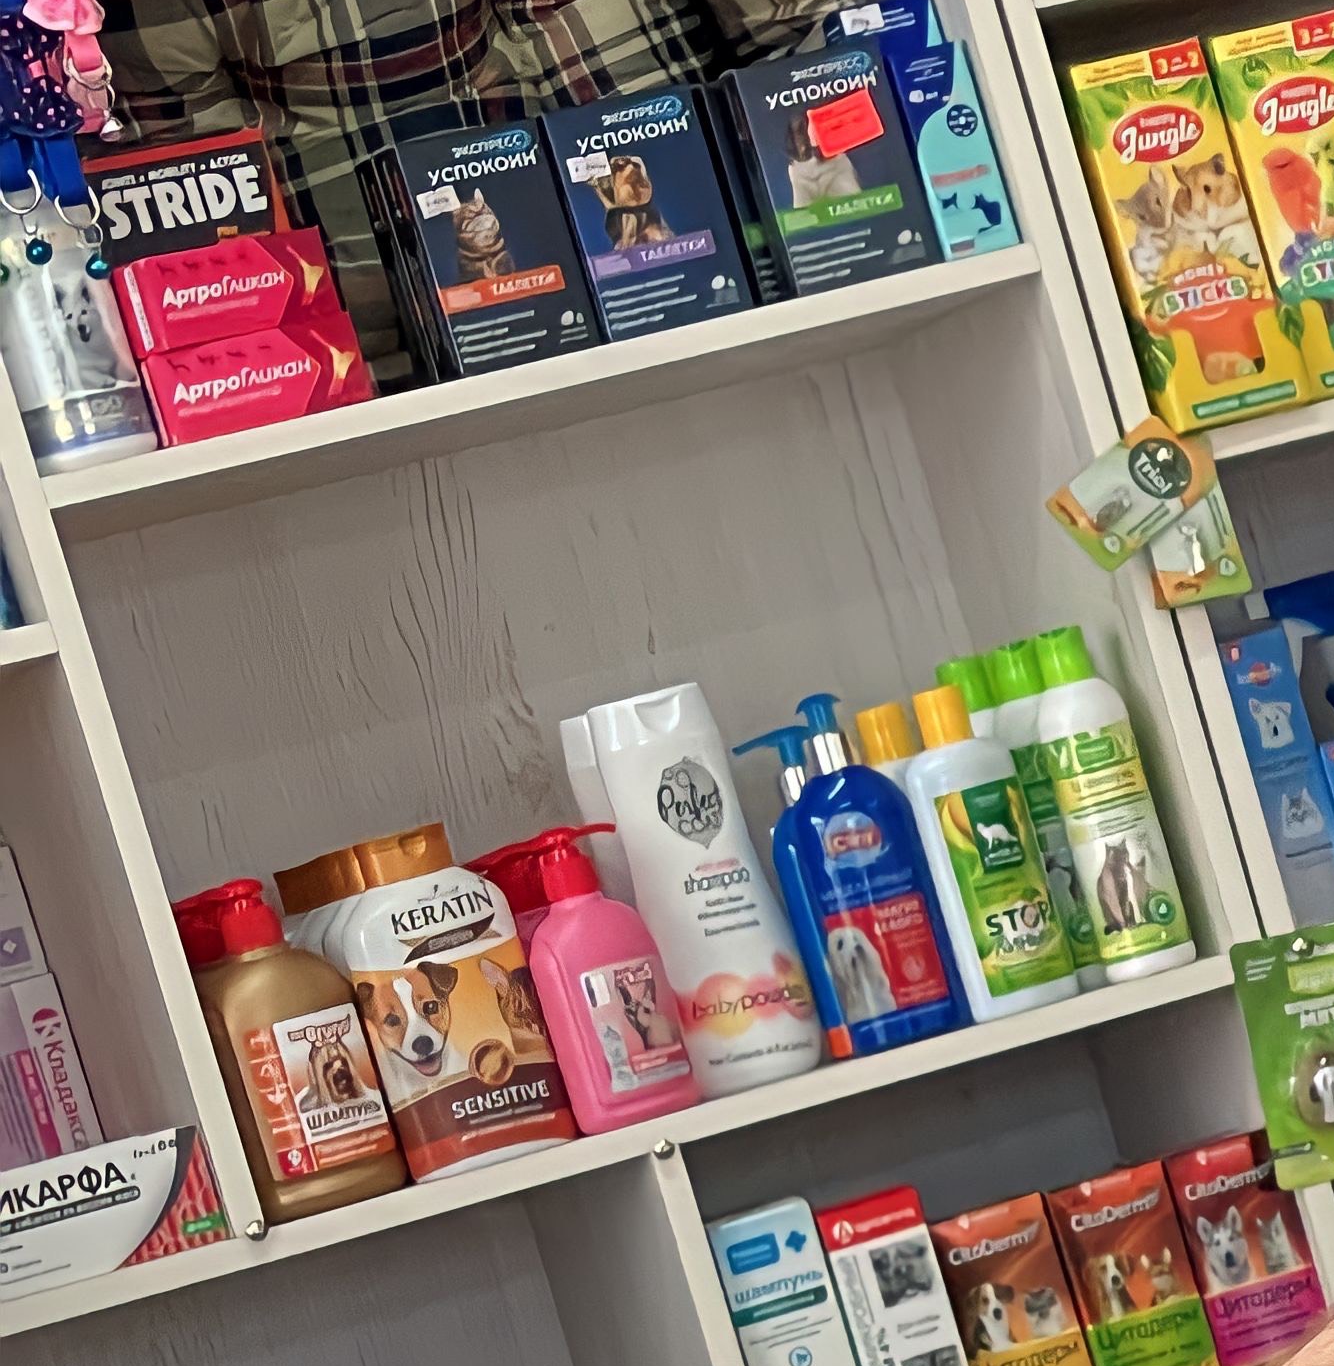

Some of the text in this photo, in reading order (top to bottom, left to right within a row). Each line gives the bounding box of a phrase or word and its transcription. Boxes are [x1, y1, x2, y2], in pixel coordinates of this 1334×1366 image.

[765, 72, 877, 110] УСПОКОИН
[576, 119, 690, 155] УСПОКОИН
[1119, 114, 1199, 164] Jungle
[427, 145, 538, 186] УСПОКОИН
[101, 165, 269, 241] STRIDE
[1163, 275, 1249, 316] STICKS
[390, 878, 495, 935] KERATIN
[985, 900, 1050, 938] STOP
[451, 1078, 551, 1121] SENSITIVE
